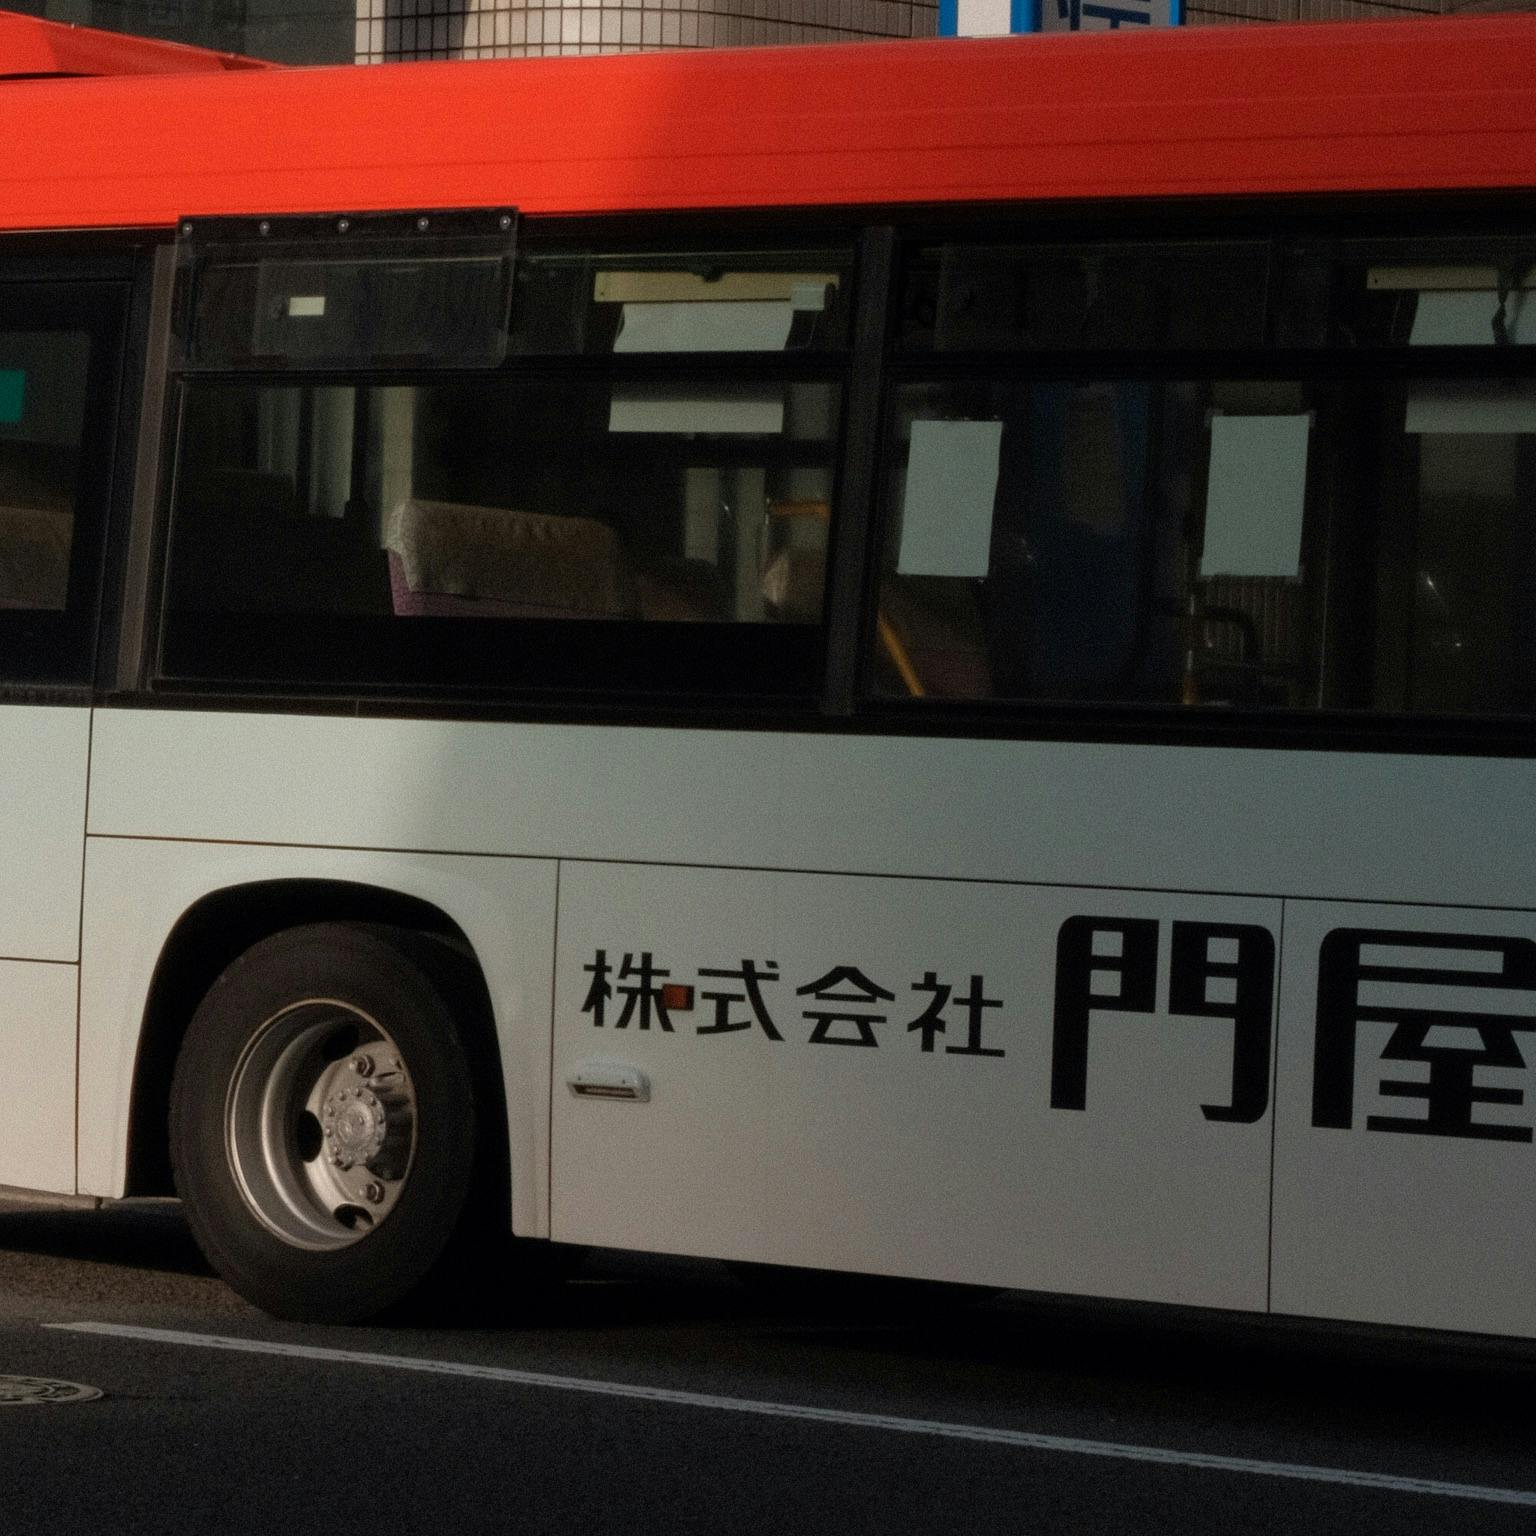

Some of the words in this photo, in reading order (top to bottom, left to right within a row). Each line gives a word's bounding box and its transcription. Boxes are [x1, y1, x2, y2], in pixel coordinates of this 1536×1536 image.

[581, 948, 1006, 1058] 株式会社
[1050, 914, 1536, 1144] 門屋
